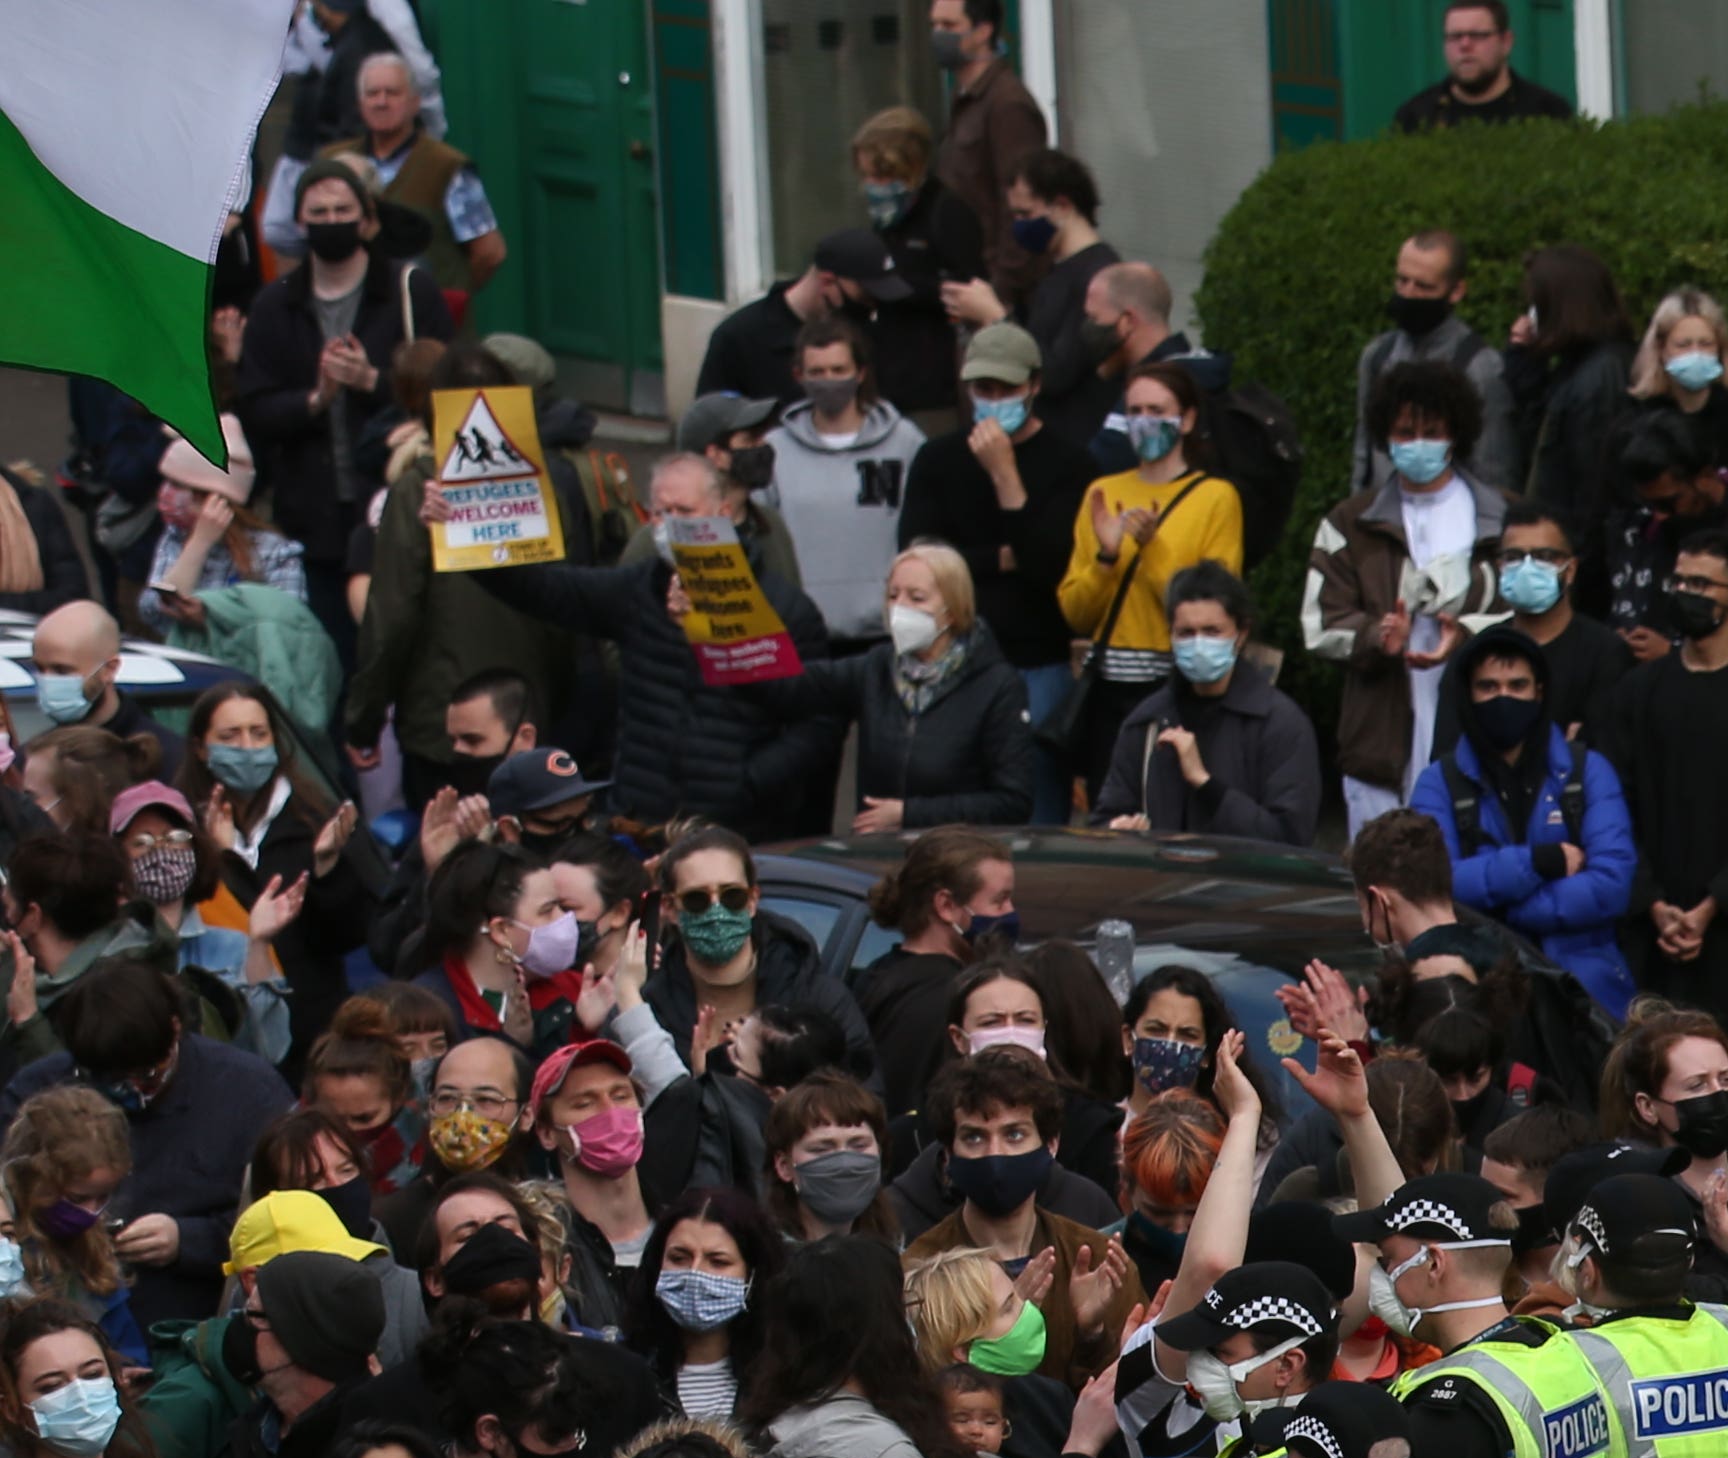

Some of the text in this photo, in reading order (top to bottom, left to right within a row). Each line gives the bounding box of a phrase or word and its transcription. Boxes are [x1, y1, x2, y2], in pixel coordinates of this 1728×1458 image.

[442, 481, 540, 503] REFUGEES
[449, 500, 542, 523] WELCOME
[471, 522, 523, 542] HERE
[545, 750, 578, 777] C
